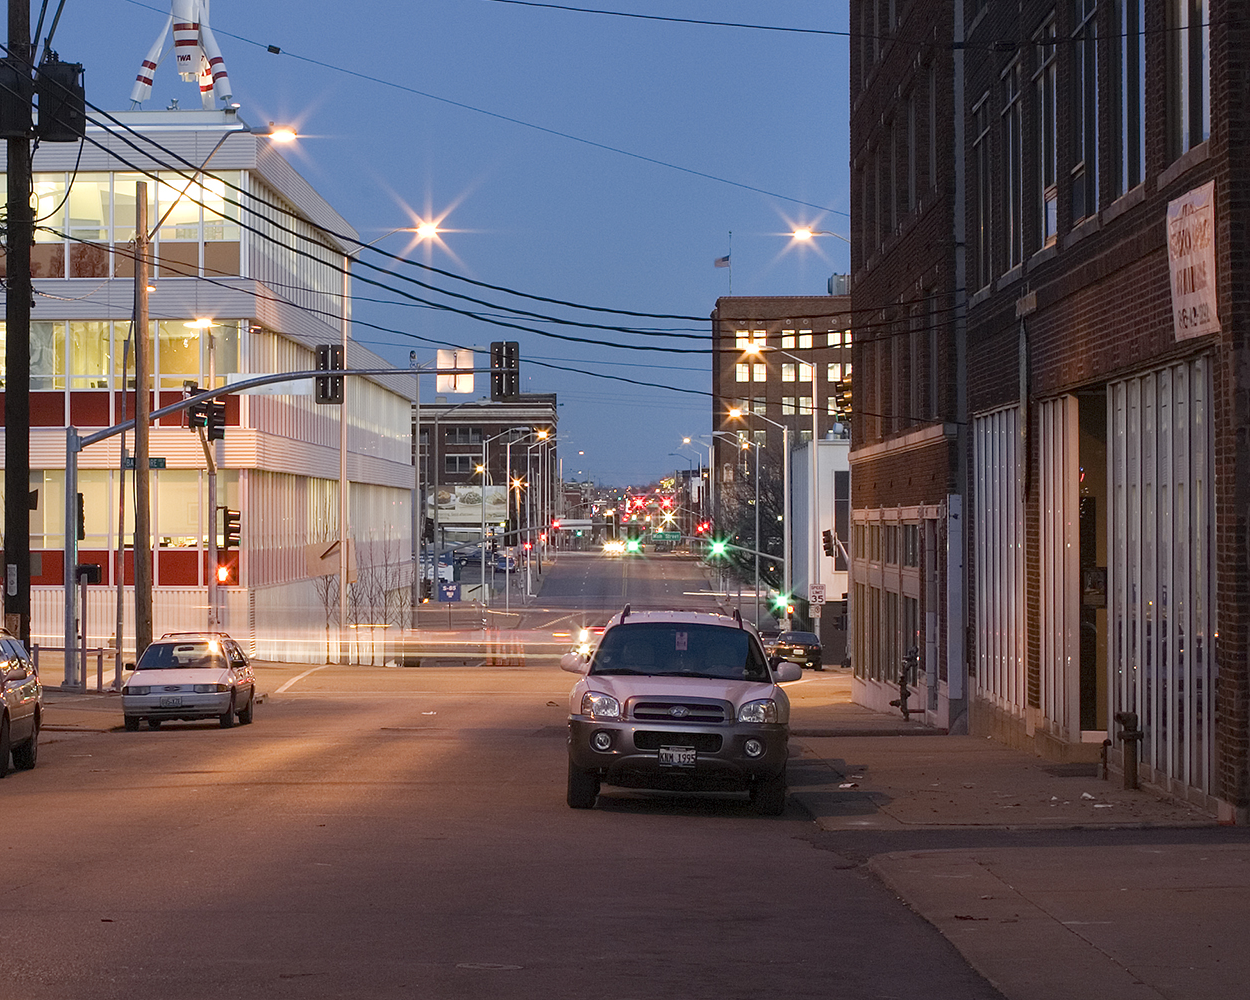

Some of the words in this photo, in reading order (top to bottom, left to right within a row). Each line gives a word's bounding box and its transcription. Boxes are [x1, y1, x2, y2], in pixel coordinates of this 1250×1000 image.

[177, 54, 191, 62] TWA
[811, 595, 824, 603] 35
[677, 752, 696, 764] 1995
